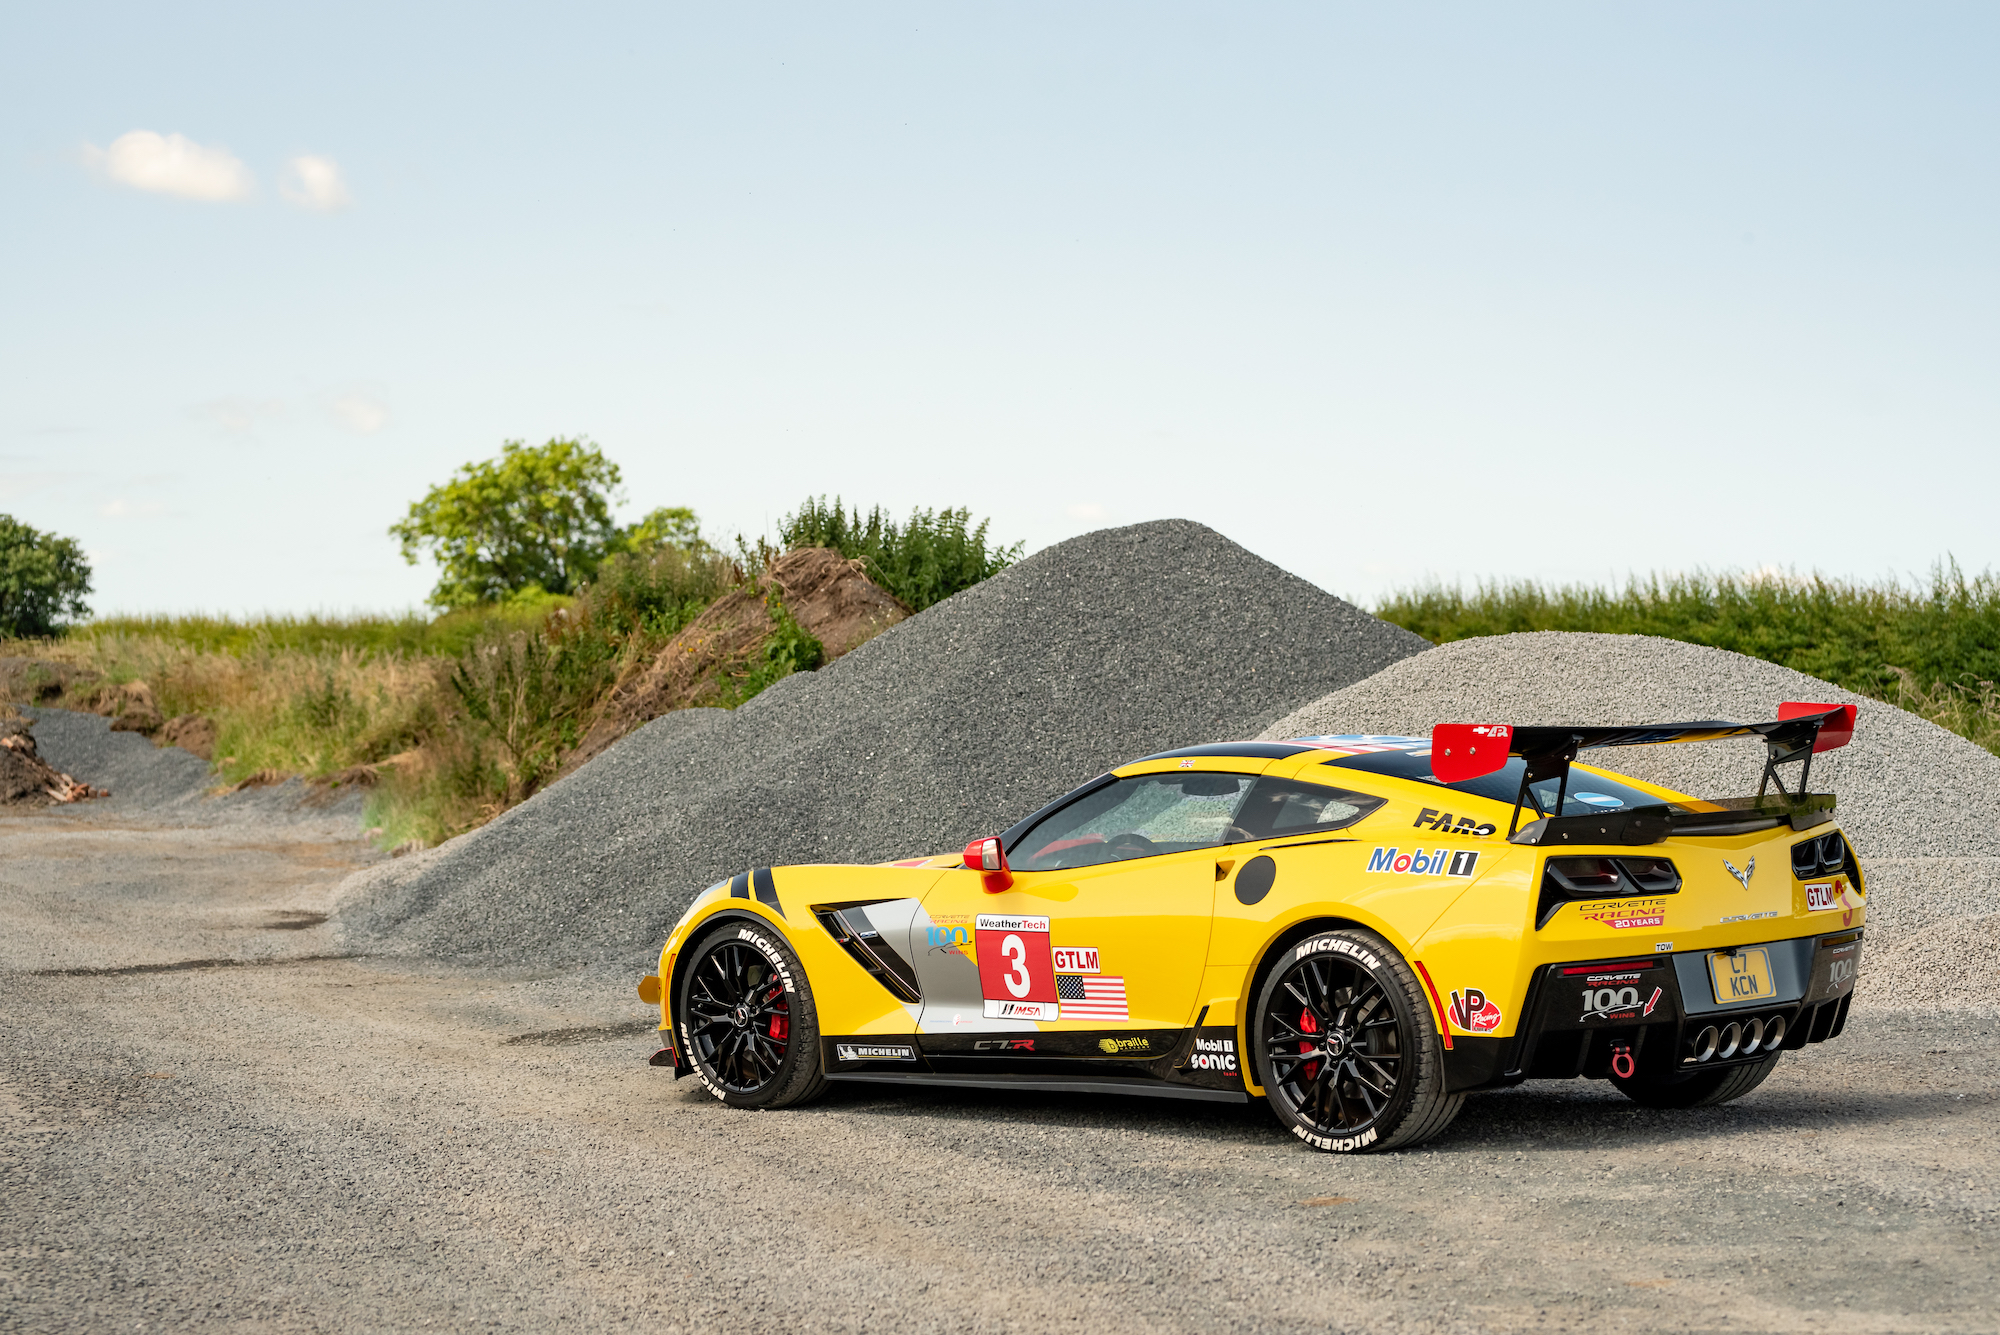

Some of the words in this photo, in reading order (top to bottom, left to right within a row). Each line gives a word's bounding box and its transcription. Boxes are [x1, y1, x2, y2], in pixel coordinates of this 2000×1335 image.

[1413, 808, 1496, 836] FARO
[1367, 848, 1448, 875] Mobil
[1580, 898, 1667, 911] CORVETTE
[1807, 887, 1836, 907] GTLM
[980, 918, 1047, 930] WeatherTech
[1579, 907, 1665, 921] RACING
[1614, 919, 1630, 928] 20
[1631, 917, 1661, 926] YEARS
[925, 926, 968, 946] 100
[1296, 938, 1381, 971] MICHELIN
[1656, 943, 1673, 951] TOW
[737, 928, 796, 993] MICHELIN
[1001, 933, 1031, 998] 3
[1054, 950, 1099, 970] GTLM
[1730, 954, 1747, 974] C7
[1586, 973, 1641, 982] CORVETTE
[1730, 974, 1759, 997] KCN
[1450, 988, 1485, 1031] VP
[1582, 987, 1639, 1012] 100
[1013, 1006, 1041, 1017] IMSA
[858, 1047, 910, 1057] MICHELIN
[1115, 1037, 1149, 1048] braille
[1196, 1038, 1223, 1052] Mobil
[680, 1021, 727, 1101] MICHELIN
[1292, 1124, 1378, 1151] MICHELIN
